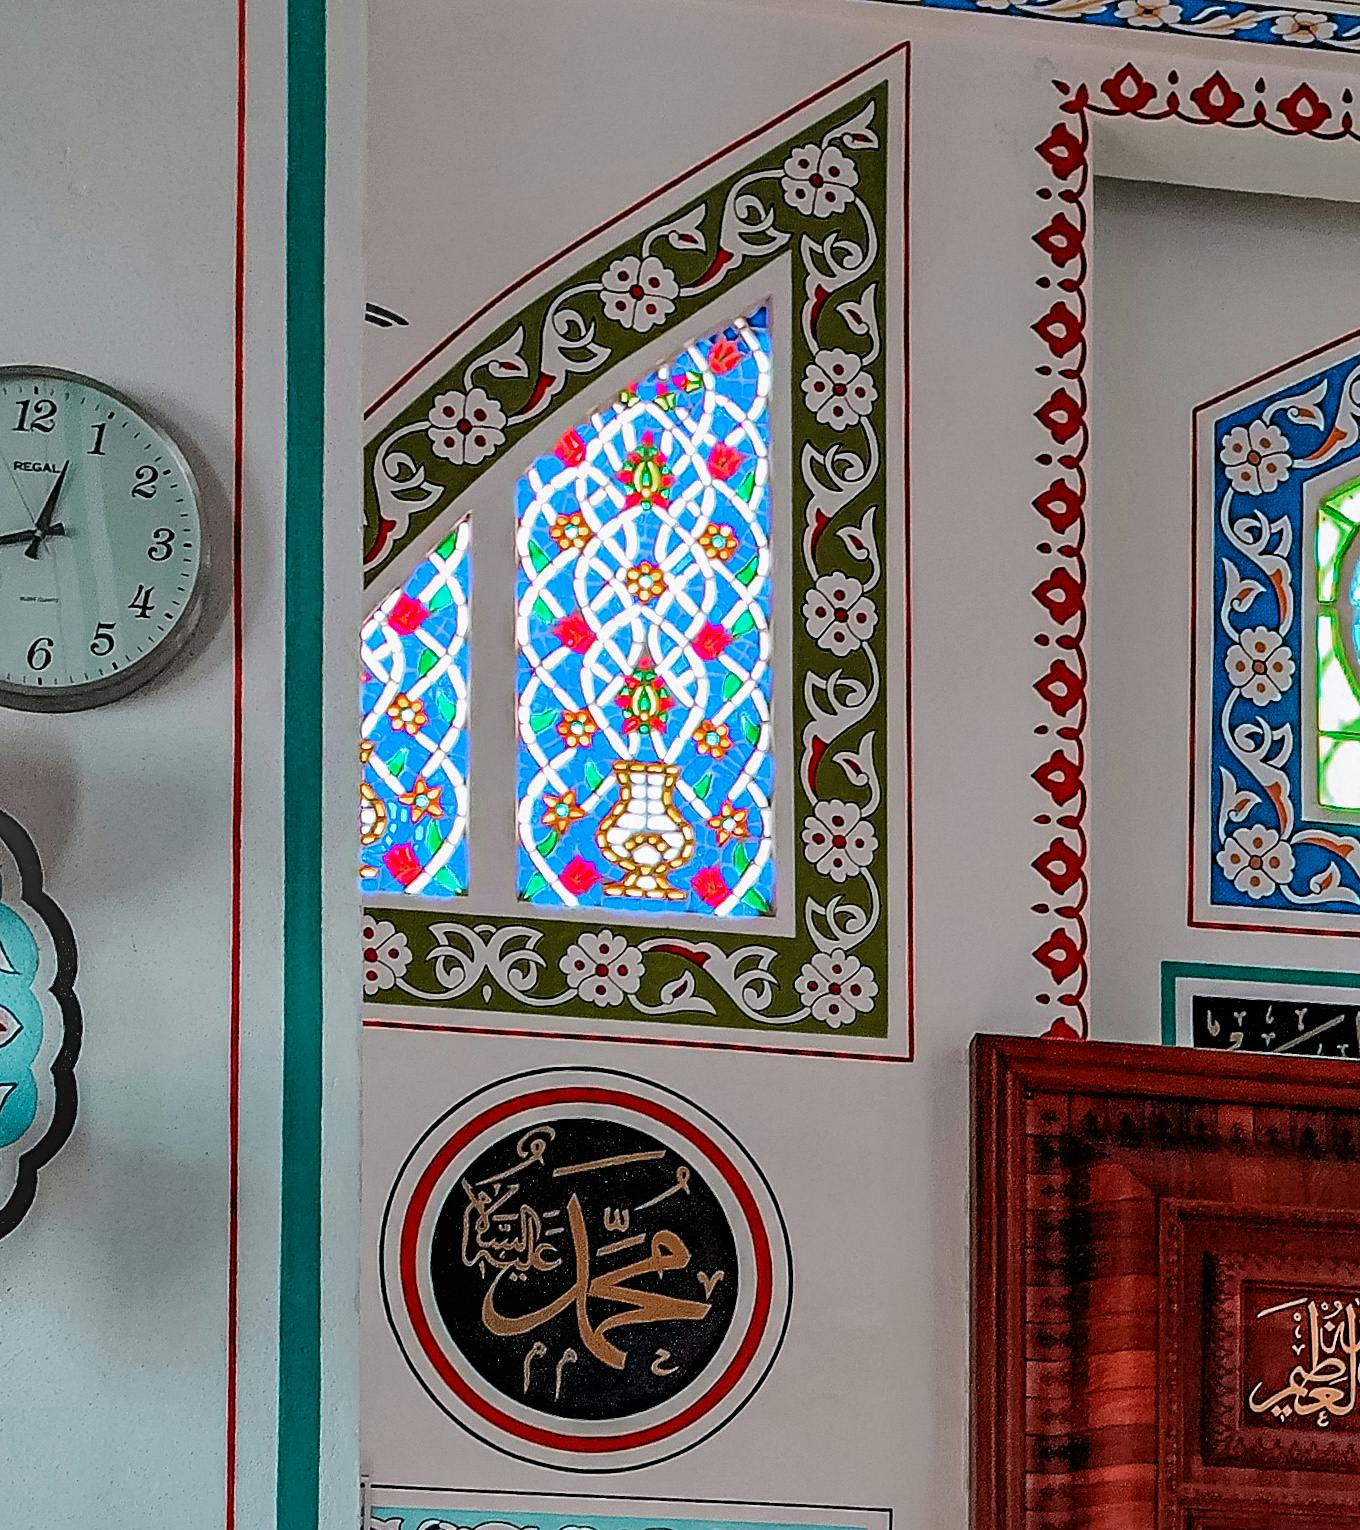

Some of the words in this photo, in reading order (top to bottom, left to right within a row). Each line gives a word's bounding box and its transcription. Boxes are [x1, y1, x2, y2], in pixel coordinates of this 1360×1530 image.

[12, 399, 57, 432] 12
[86, 423, 107, 456] 1
[13, 460, 62, 474] REGAL
[131, 465, 159, 499] 2
[147, 528, 176, 561] 3
[128, 584, 155, 619] 4
[26, 637, 54, 671] 6
[90, 622, 117, 656] 5
[482, 1193, 712, 1371] محمد
